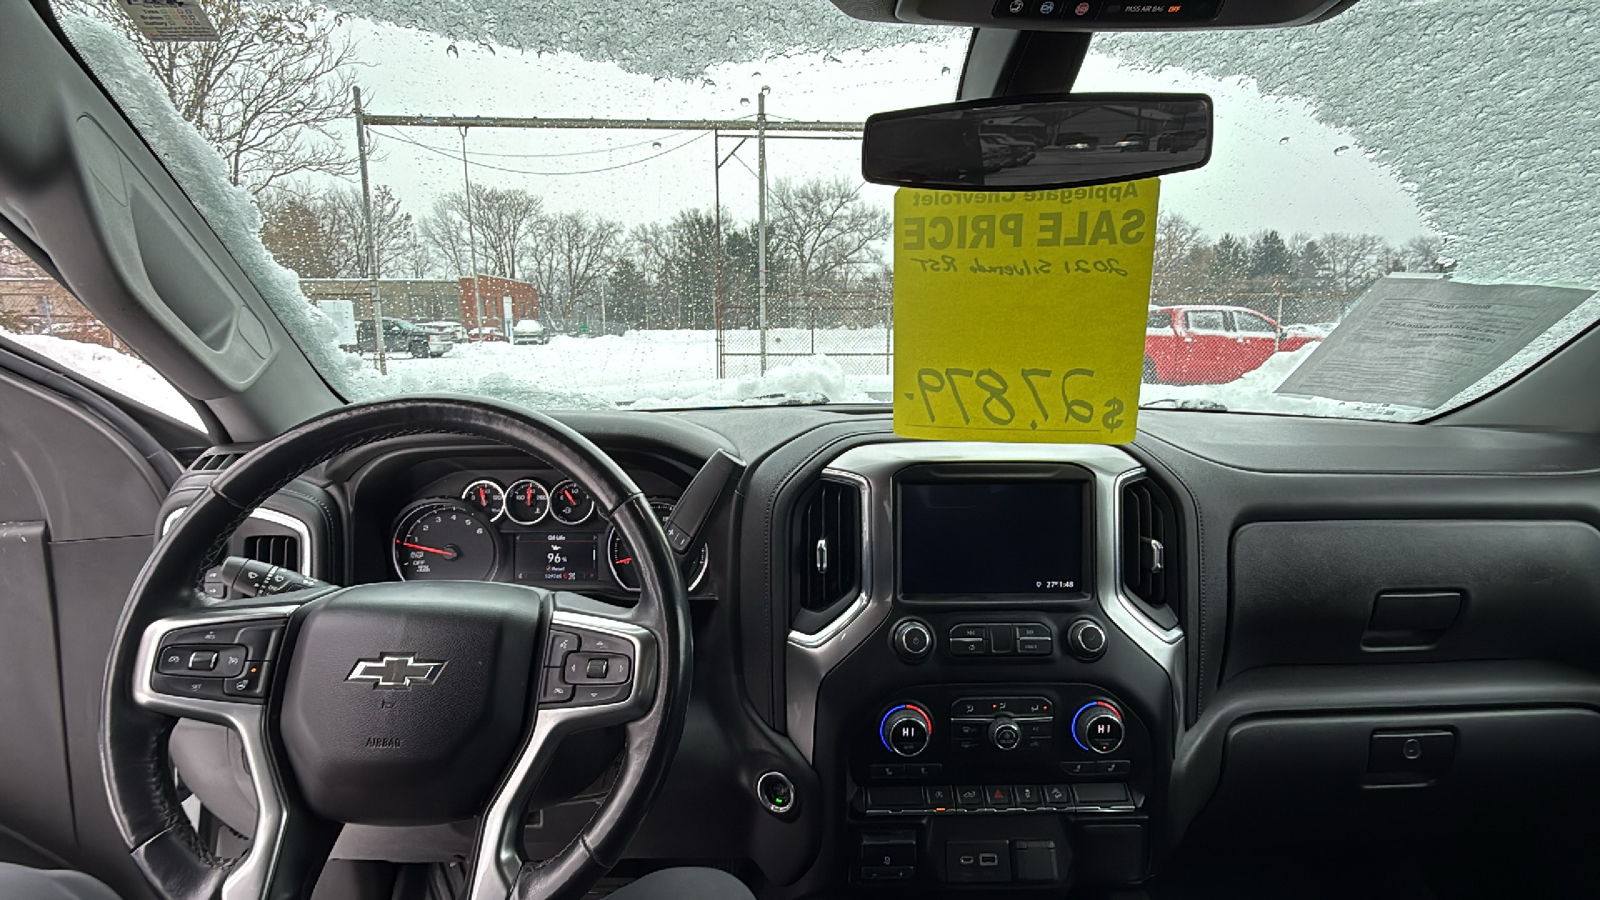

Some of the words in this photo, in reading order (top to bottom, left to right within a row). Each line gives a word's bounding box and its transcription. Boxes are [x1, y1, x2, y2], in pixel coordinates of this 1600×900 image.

[1167, 5, 1182, 13] OFF
[547, 552, 561, 563] 96
[902, 727, 915, 737] HI
[1097, 724, 1111, 734] HI
[365, 737, 401, 748] AIRBAG
